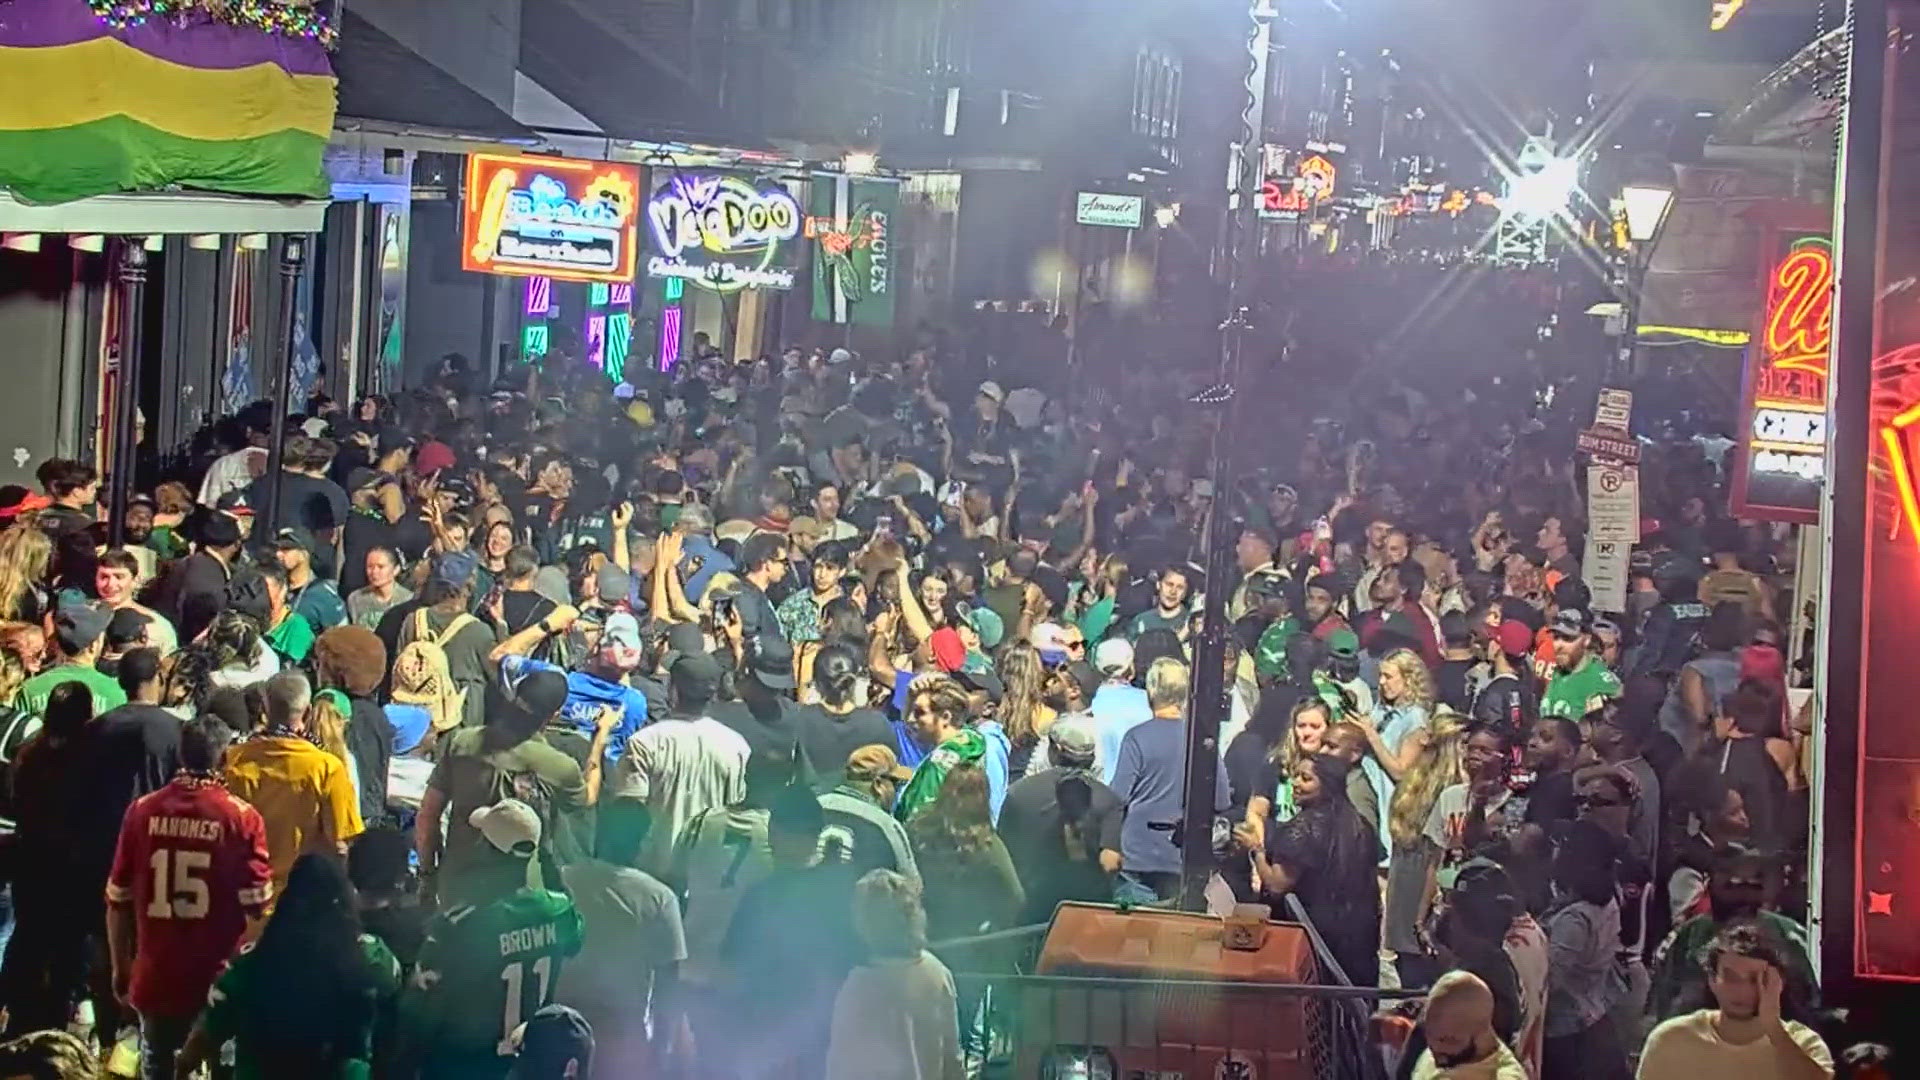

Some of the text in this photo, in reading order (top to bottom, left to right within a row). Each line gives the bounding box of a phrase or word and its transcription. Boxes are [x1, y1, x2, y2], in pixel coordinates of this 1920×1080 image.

[1600, 440, 1637, 457] STREET
[148, 815, 220, 840] MAHOMES
[147, 847, 212, 919] 15
[500, 922, 557, 956] BROWN
[497, 956, 552, 1056] 11
